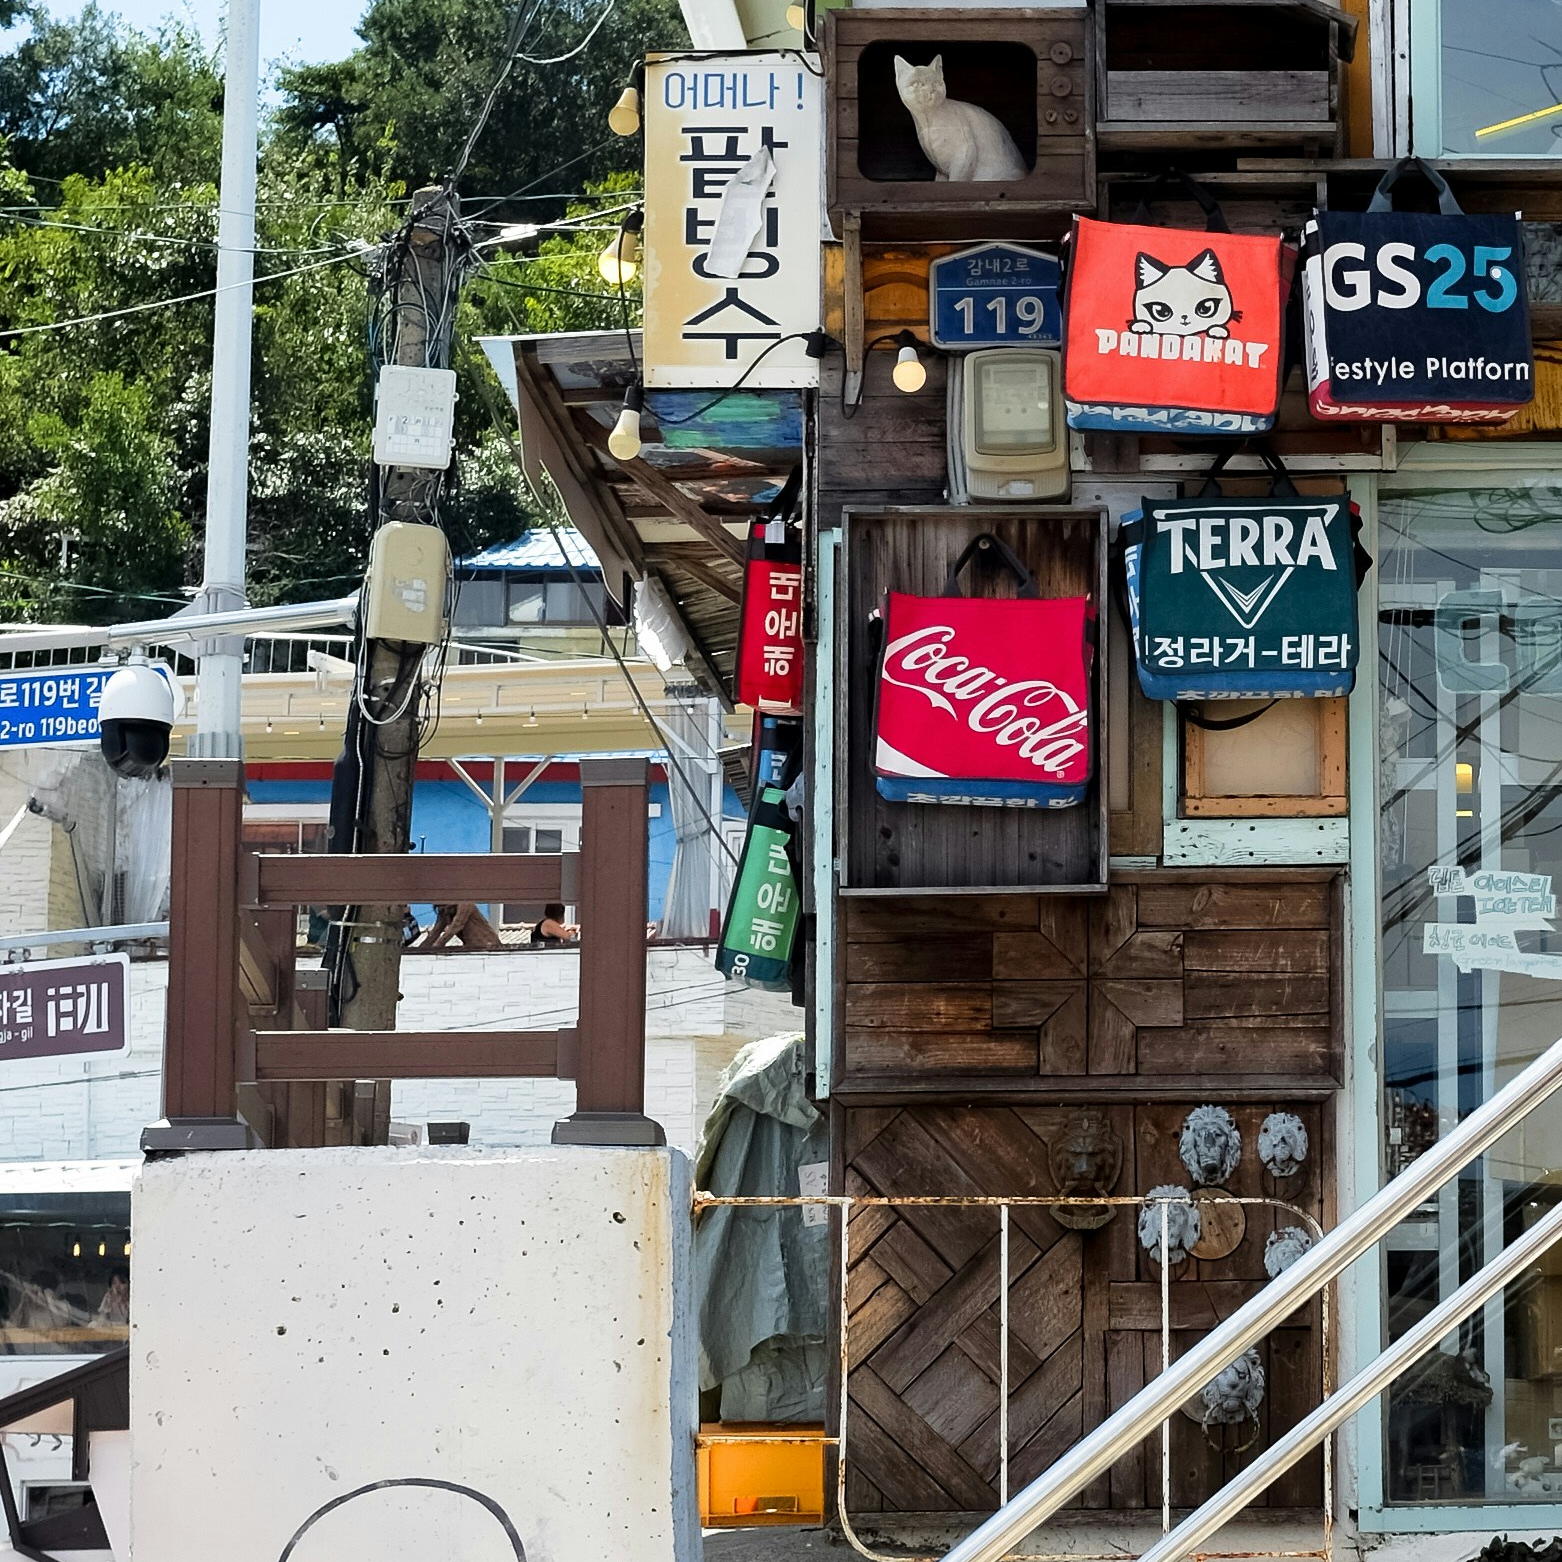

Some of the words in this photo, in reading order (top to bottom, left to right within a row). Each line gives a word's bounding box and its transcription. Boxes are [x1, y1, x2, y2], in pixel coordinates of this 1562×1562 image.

[966, 277, 1009, 287] Gamnae
[1011, 276, 1032, 286] 2-ro
[967, 258, 1030, 276] 감내2로
[1322, 241, 1518, 313] GS25
[953, 295, 1045, 335] 119
[1094, 328, 1269, 369] PANDAKAT
[1330, 356, 1416, 386] estyle
[1156, 515, 1338, 575] TERRA
[1144, 632, 1352, 670] 정라거-테라
[1473, 873, 1549, 899] 아이스티
